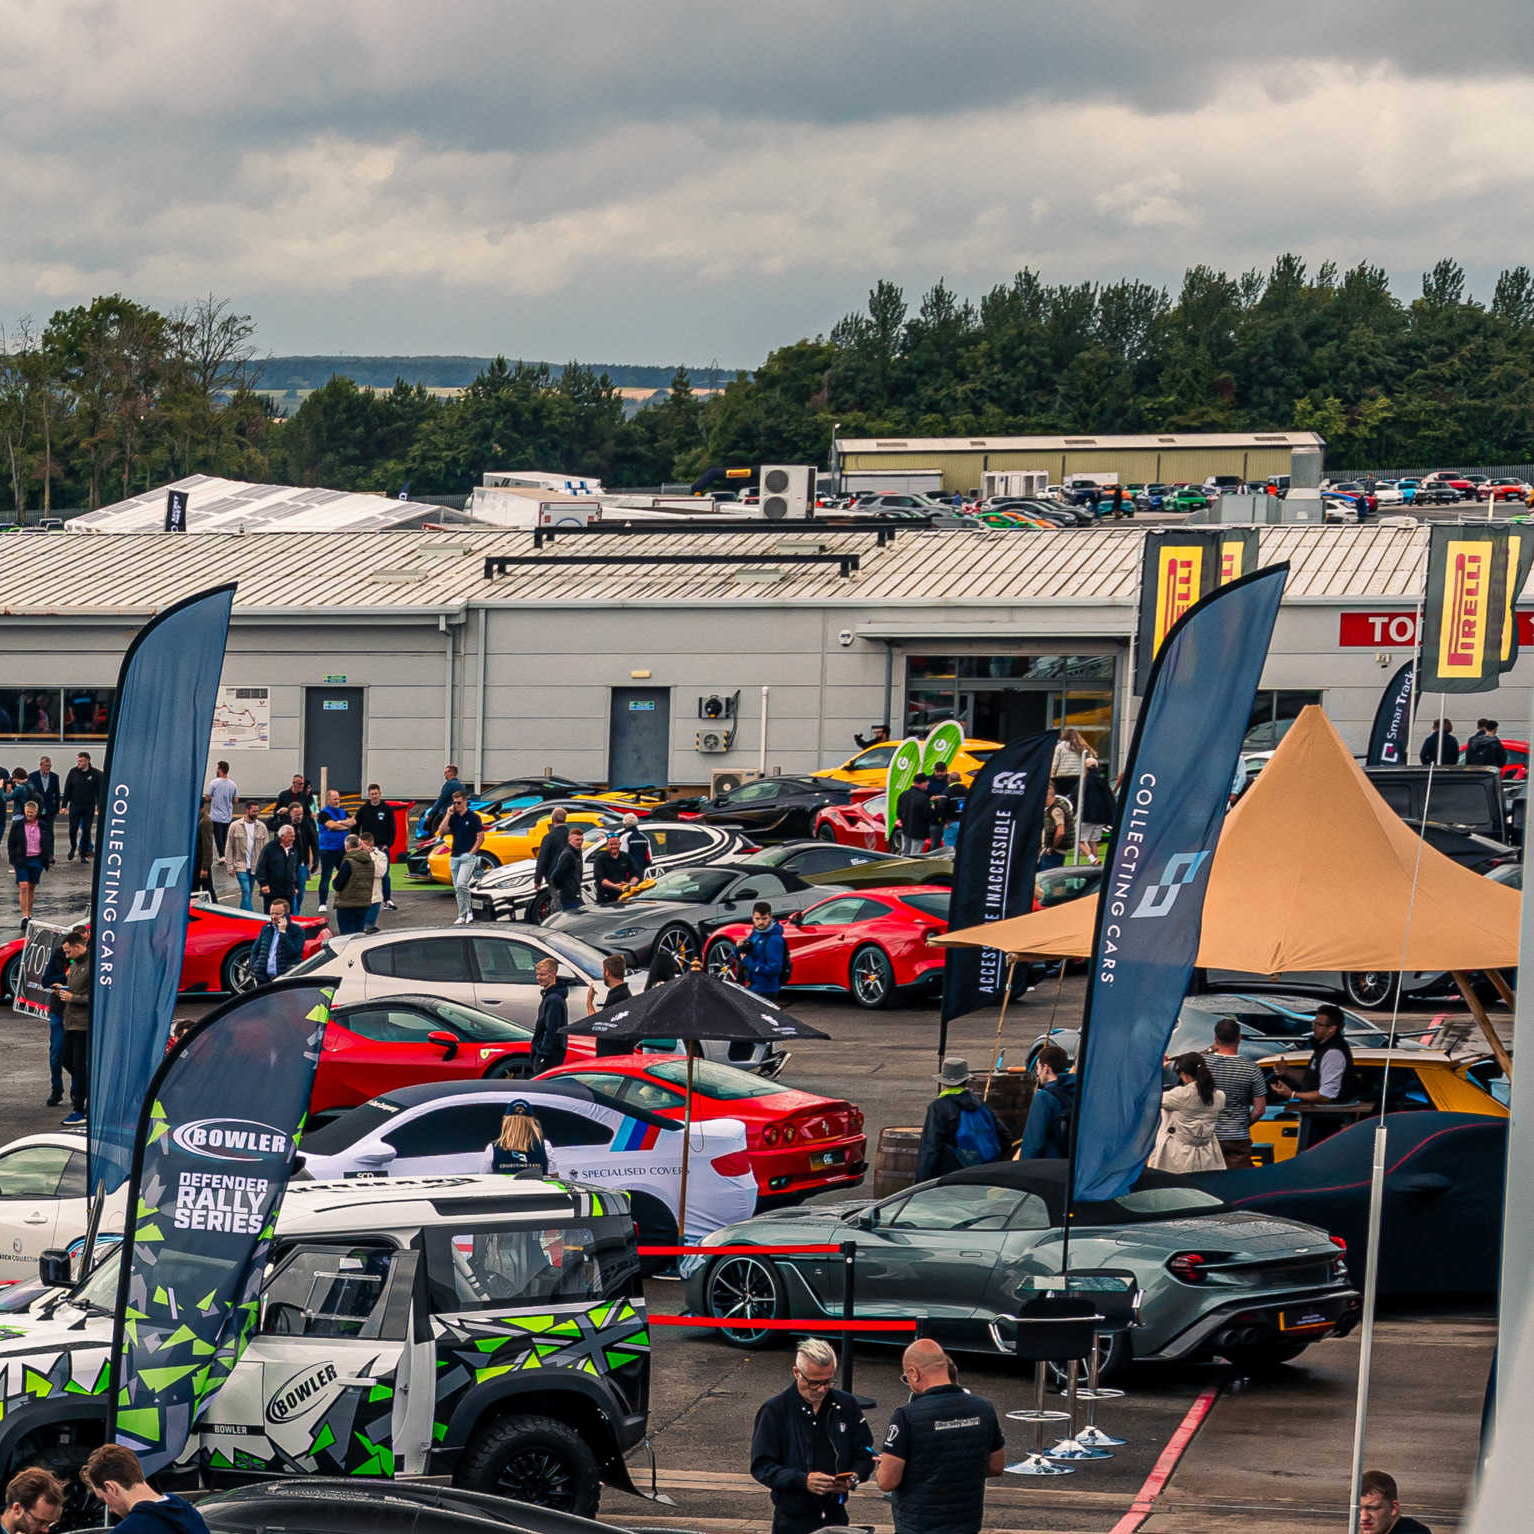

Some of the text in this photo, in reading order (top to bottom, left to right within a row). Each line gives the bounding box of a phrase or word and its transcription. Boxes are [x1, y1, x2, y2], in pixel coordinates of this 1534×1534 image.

[1446, 553, 1481, 666] PIRELLI
[985, 809, 1012, 908] INACCESSIBLE
[99, 783, 130, 988] COLLECTING CARS
[1100, 772, 1156, 985] COLLECTING CARS
[191, 1127, 287, 1154] BOWLER
[178, 1172, 268, 1193] DEFENDER
[582, 1167, 647, 1179] SPECIALISED
[176, 1188, 266, 1216] RALLY
[174, 1209, 263, 1234] SERIES
[273, 1361, 337, 1422] BOWLER
[214, 1425, 248, 1435] BOWLER
